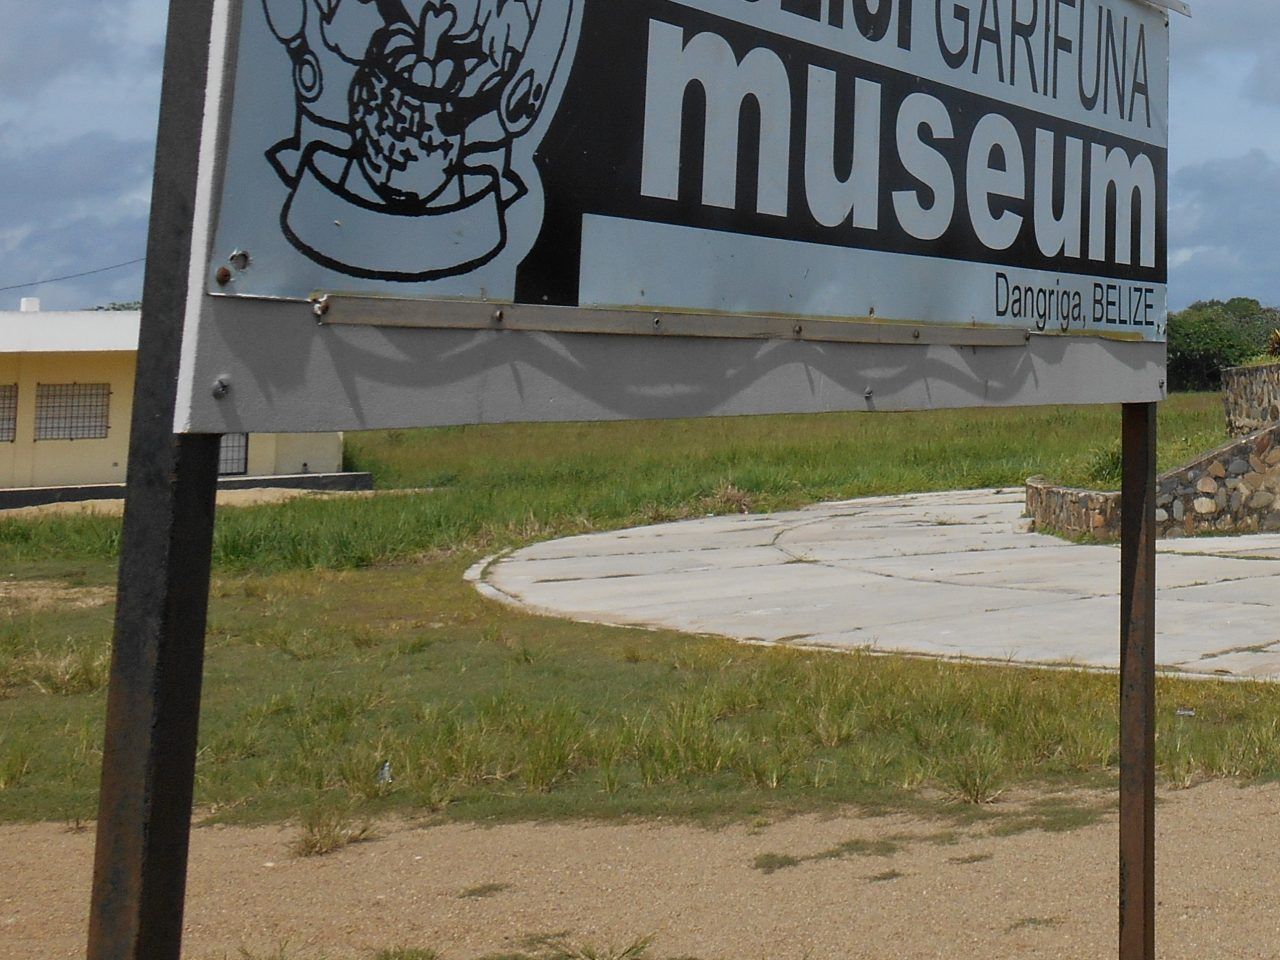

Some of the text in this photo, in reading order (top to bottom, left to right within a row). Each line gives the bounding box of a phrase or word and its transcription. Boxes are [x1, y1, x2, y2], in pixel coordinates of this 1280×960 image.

[640, 18, 1156, 268] museum
[995, 272, 1154, 332] Dangriga, BELIZE
